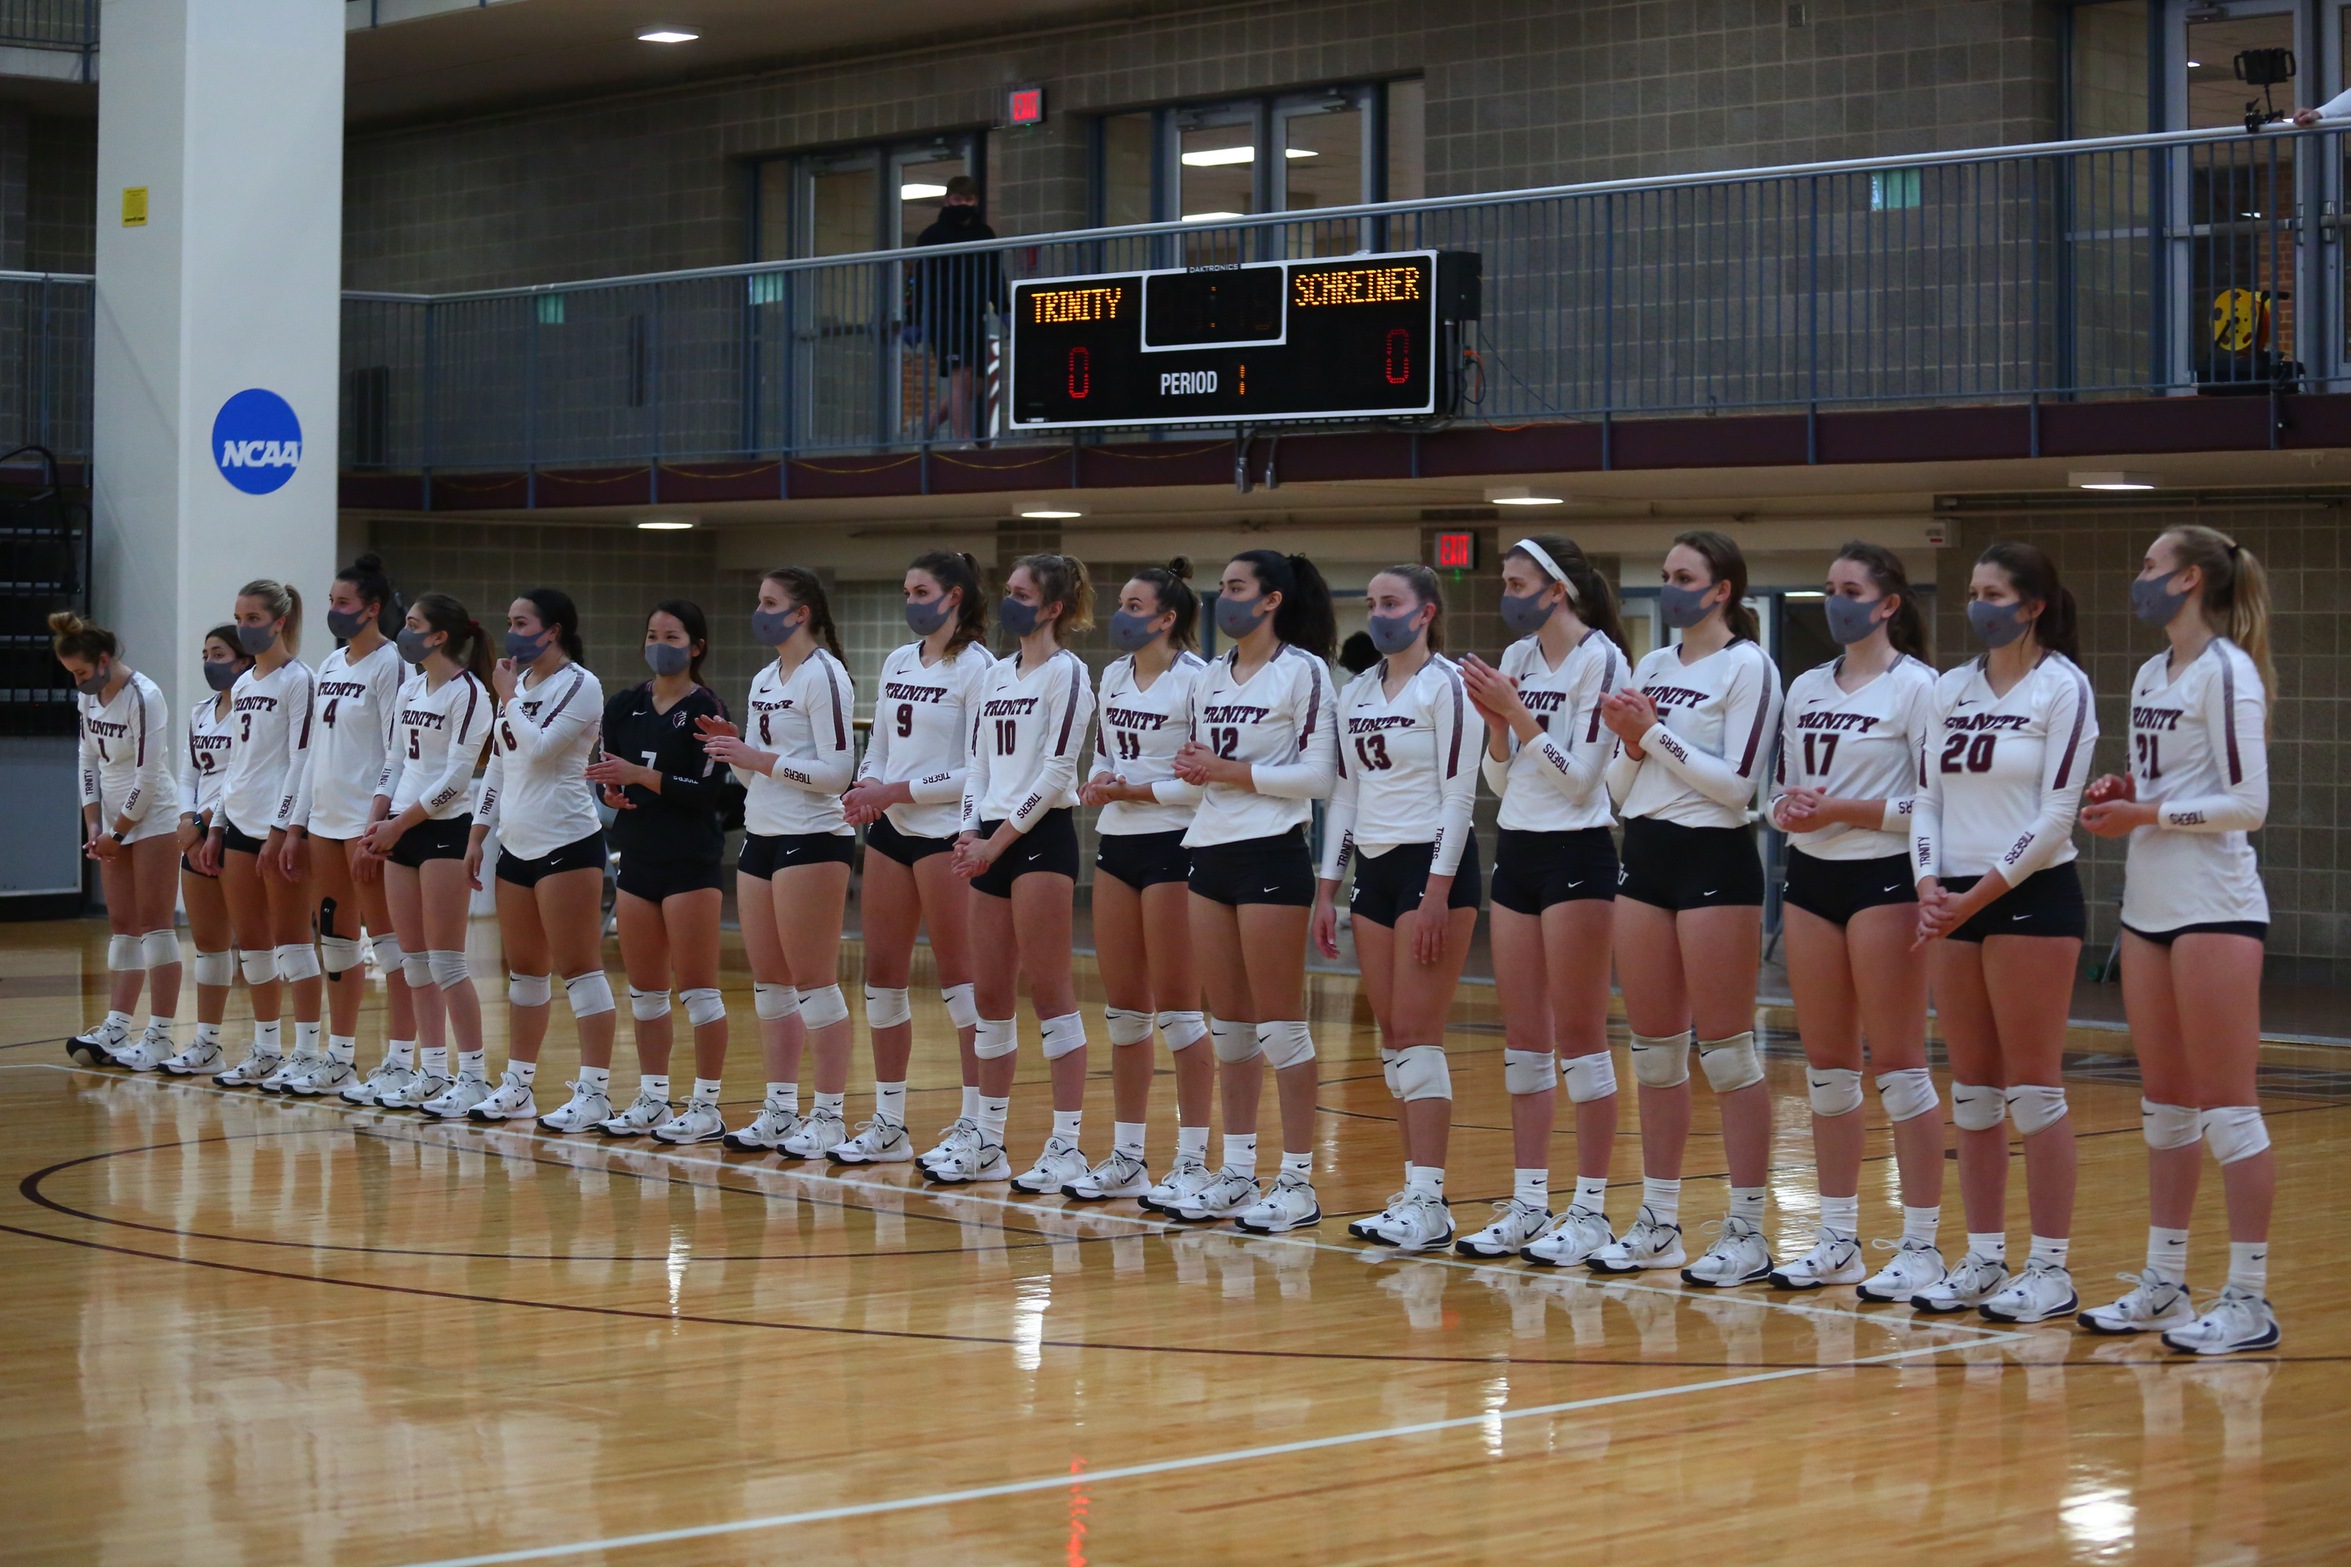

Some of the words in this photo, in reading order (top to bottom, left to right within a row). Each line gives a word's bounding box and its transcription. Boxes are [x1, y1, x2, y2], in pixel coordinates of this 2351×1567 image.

[1013, 91, 1039, 121] EXIT
[1189, 263, 1239, 274] DAKTRONICS
[1295, 266, 1420, 307] SCHREINER
[1031, 287, 1122, 323] TRINITY
[1386, 328, 1410, 384] 0
[1068, 346, 1090, 398] 0
[1160, 370, 1218, 396] PERIOD
[221, 440, 299, 468] NCAA
[1440, 535, 1471, 565] EXIT
[318, 682, 366, 698] TRINITY
[885, 682, 948, 704] TRINITY
[323, 698, 338, 729] 4
[896, 704, 913, 738] 9
[983, 697, 1039, 717] TRINITY
[1106, 707, 1169, 731] TRINITY
[241, 713, 252, 742] 3
[501, 721, 517, 751] 6
[759, 714, 772, 745] 8
[995, 719, 1017, 756] 10
[409, 729, 420, 760] 5
[1116, 731, 1141, 760] 11
[1210, 727, 1239, 761] 12
[1354, 733, 1393, 772] 13
[1543, 743, 1570, 775] TIGERS
[1659, 733, 1690, 765] TIGERS
[1802, 733, 1840, 776] 17
[1940, 733, 1997, 774] 20
[641, 751, 657, 770] 7
[84, 769, 93, 796] TRINITY
[783, 767, 812, 785] TIGERS
[480, 787, 498, 815] TRINITY
[963, 794, 974, 822] TRINITY
[1016, 792, 1042, 819] TIGERS
[1337, 829, 1354, 868] TRINITY
[1919, 836, 1931, 868] TRINITY
[2004, 831, 2035, 865] TIGERS
